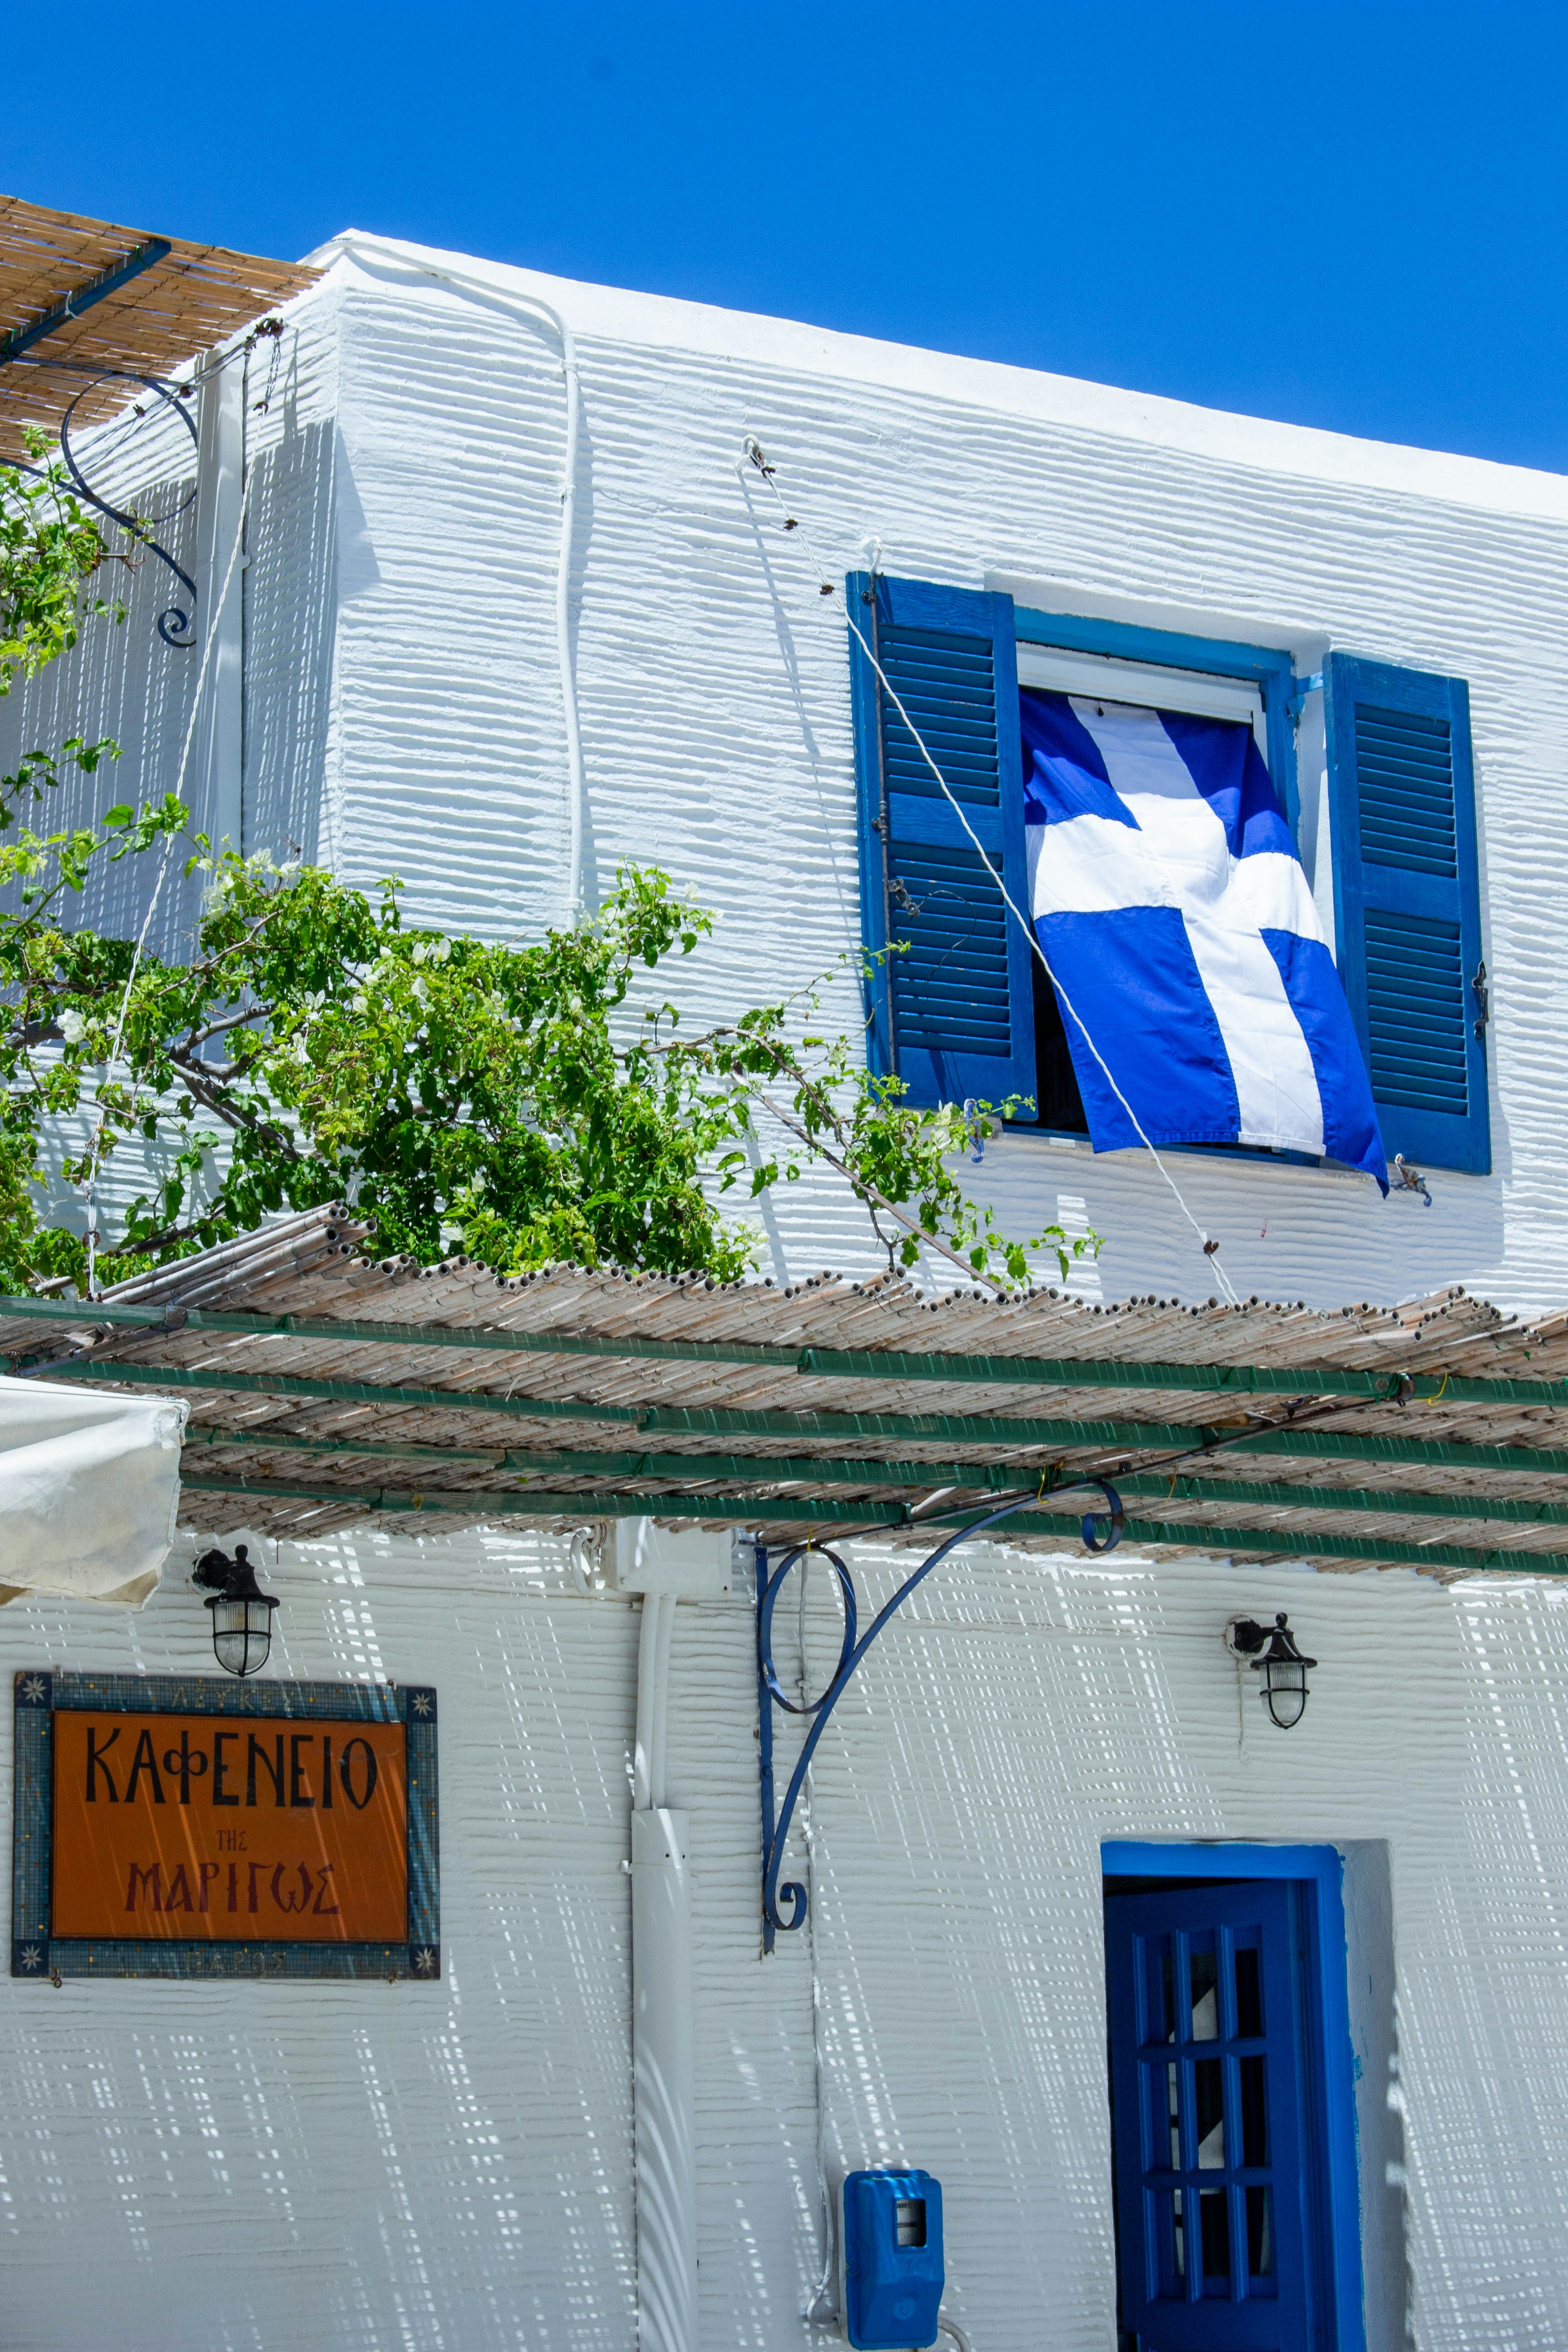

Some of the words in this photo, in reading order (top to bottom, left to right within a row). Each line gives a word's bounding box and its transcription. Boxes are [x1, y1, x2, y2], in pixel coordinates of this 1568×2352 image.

[86, 1727, 377, 1809] ΚΑΦΕΝΕΙΟ
[216, 1829, 247, 1851] ΤΗΣ
[186, 1951, 287, 1975] ΠΑΡΟΣ
